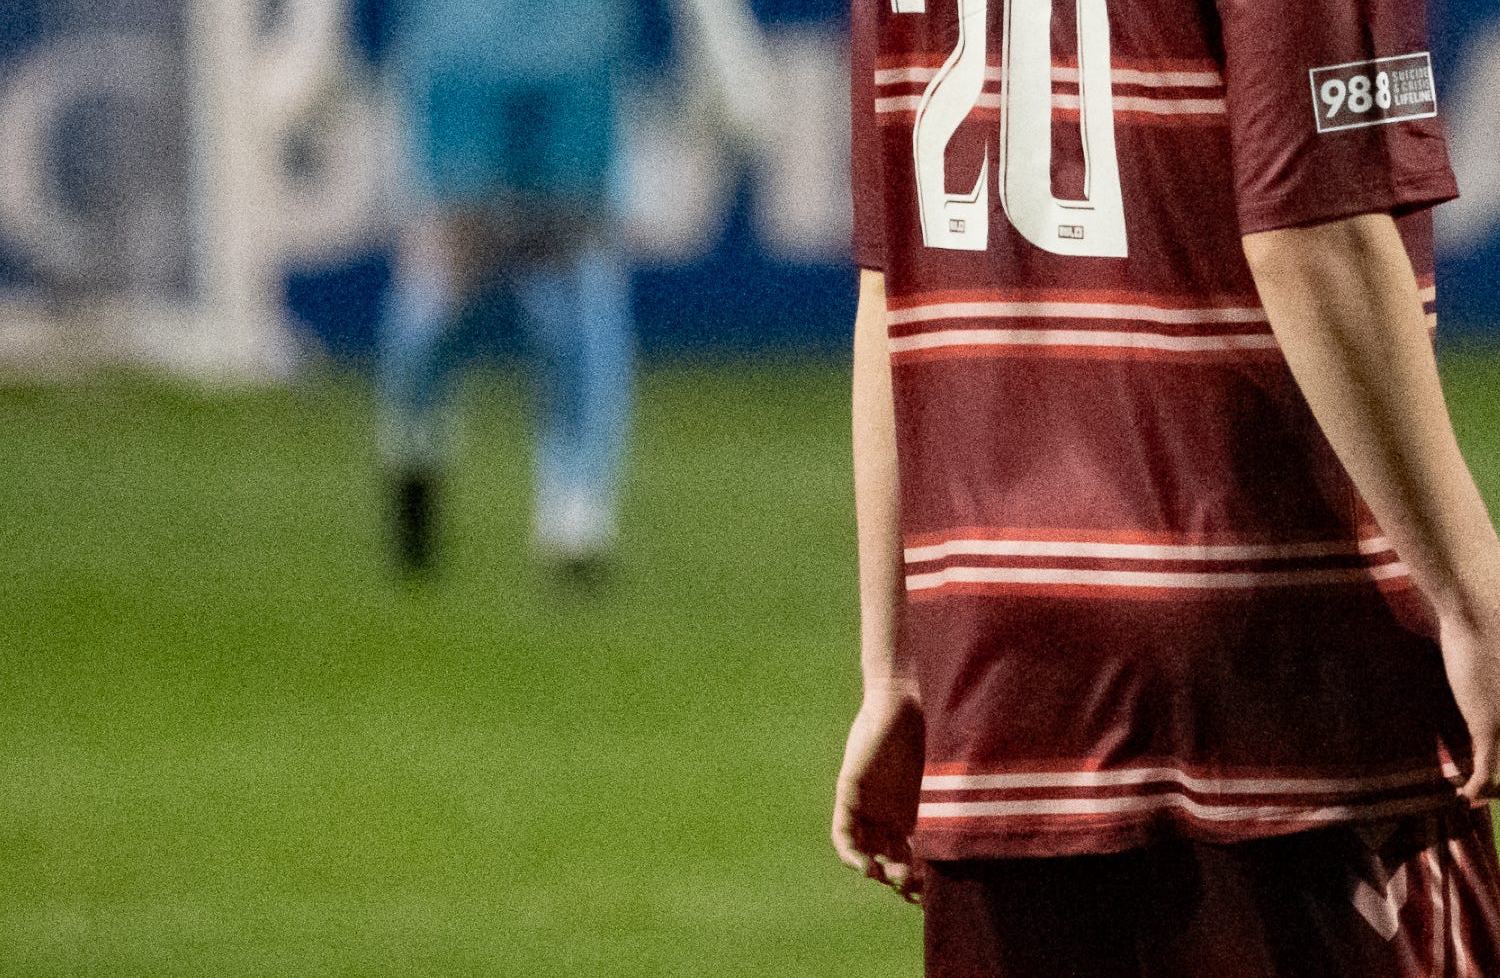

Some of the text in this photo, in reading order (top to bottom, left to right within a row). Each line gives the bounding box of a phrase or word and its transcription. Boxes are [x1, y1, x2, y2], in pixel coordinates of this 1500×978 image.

[1391, 66, 1429, 82] SUICIDE
[1401, 78, 1430, 94] CRISIS
[1320, 71, 1392, 118] 988
[1394, 90, 1433, 106] LIFELINE
